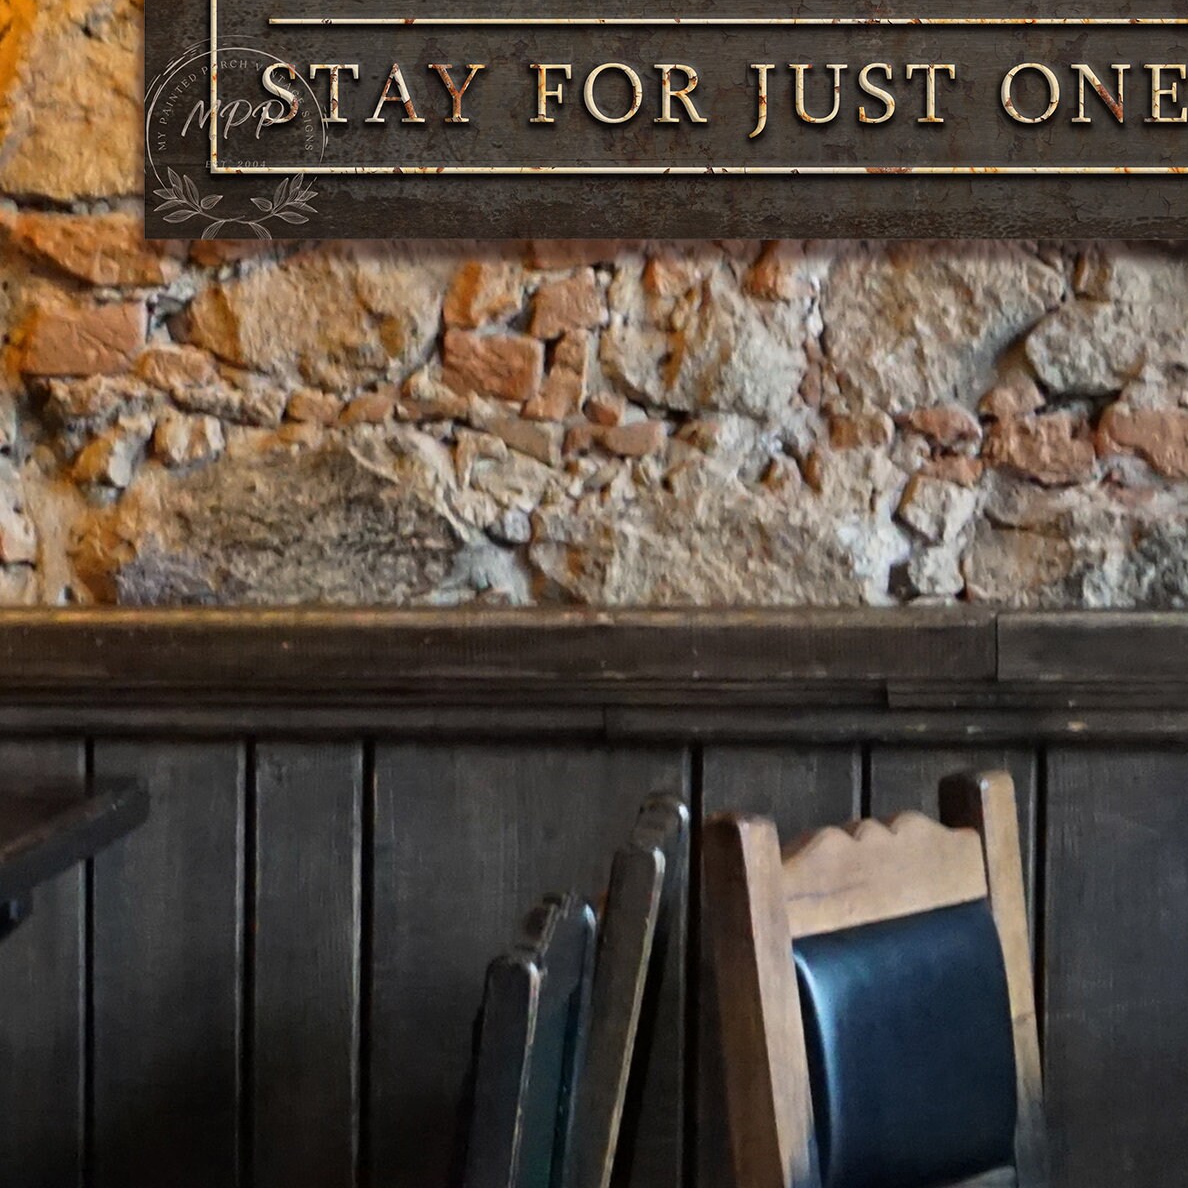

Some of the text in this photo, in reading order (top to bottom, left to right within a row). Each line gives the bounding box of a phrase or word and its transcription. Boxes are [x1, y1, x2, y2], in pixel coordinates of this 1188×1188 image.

[262, 62, 484, 124] STAY
[530, 62, 707, 123] FOR
[750, 62, 955, 137] JUST
[1001, 62, 1187, 123] ONE
